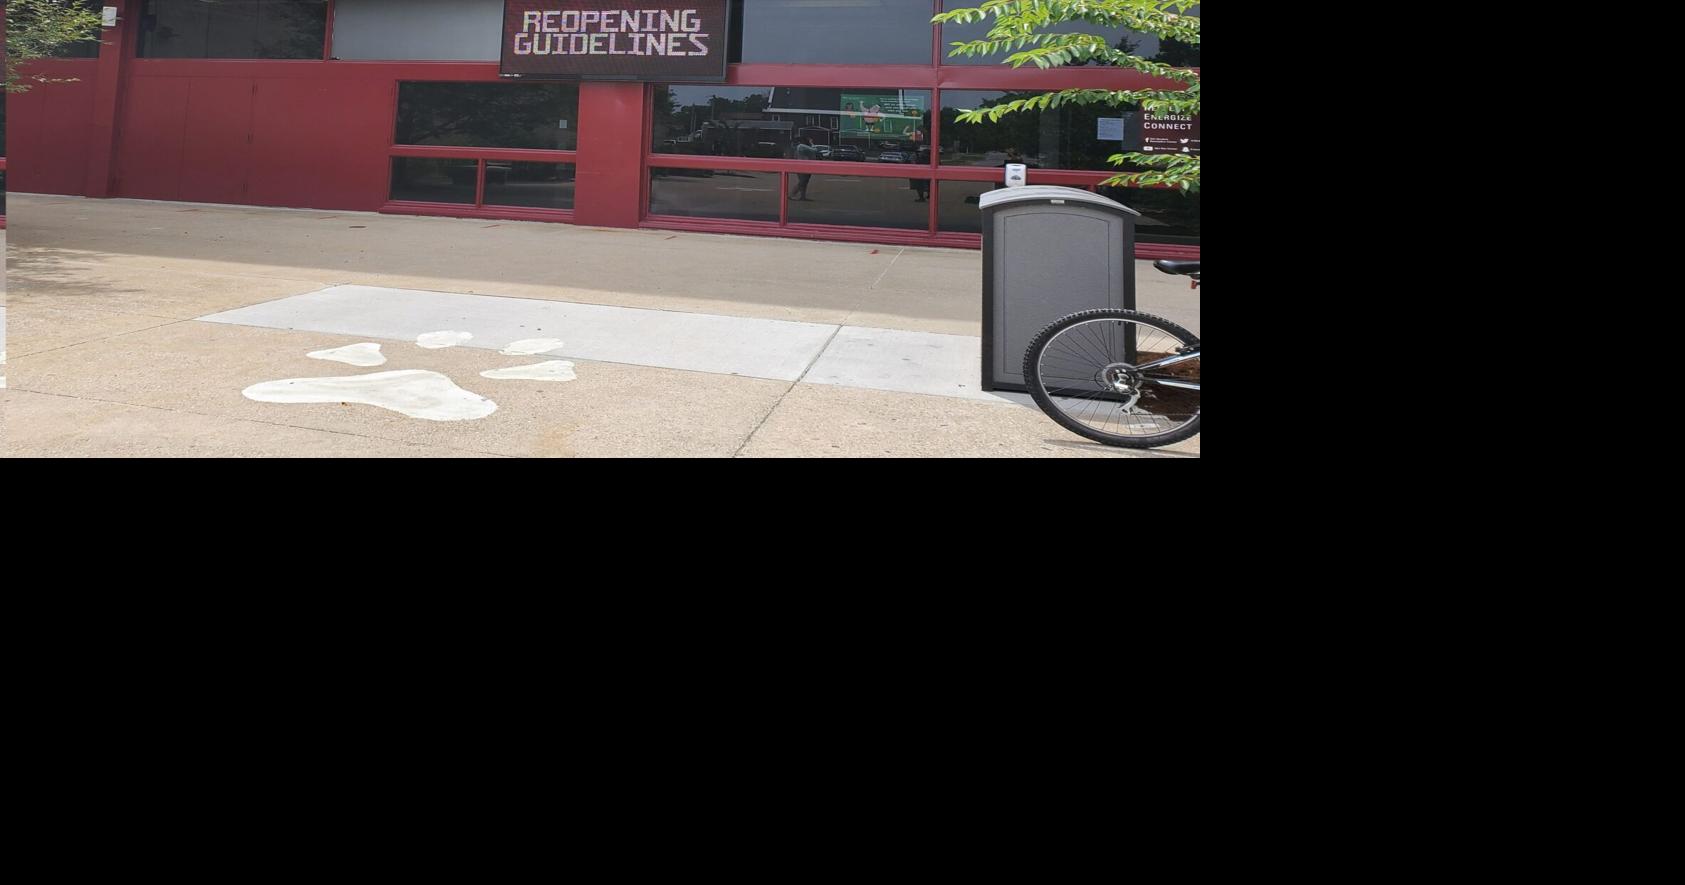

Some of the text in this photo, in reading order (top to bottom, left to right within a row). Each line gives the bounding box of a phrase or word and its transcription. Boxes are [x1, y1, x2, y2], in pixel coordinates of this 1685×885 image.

[522, 9, 701, 32] REOPENING
[513, 33, 709, 56] GUIDELINES
[1143, 122, 1193, 130] CONNECT
